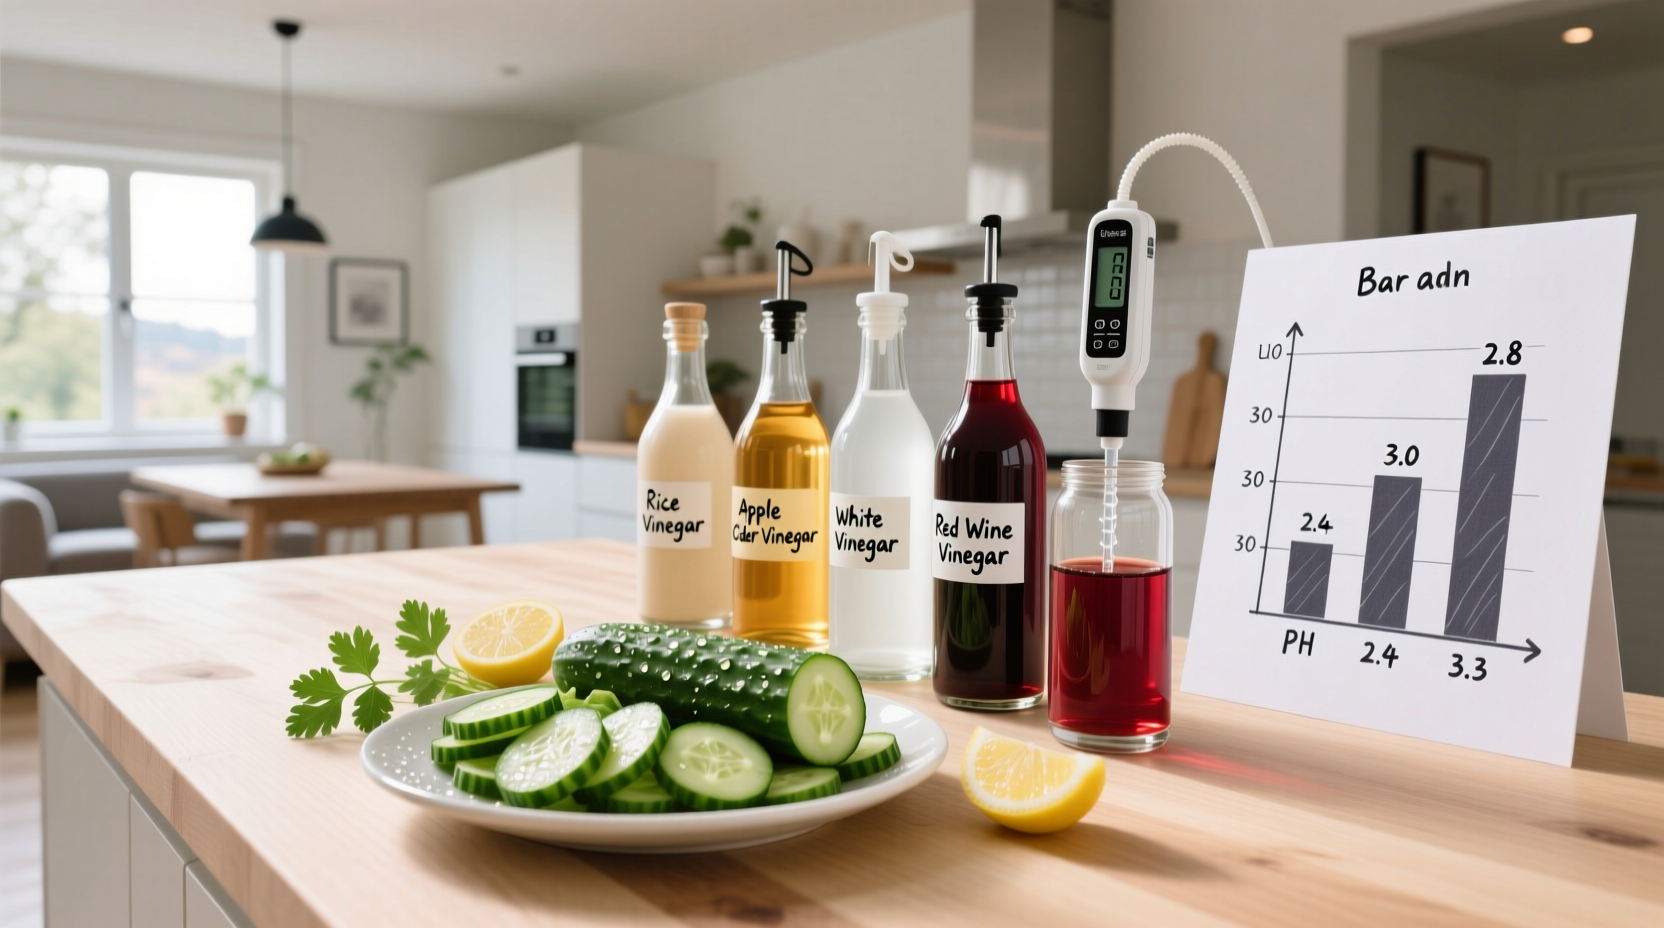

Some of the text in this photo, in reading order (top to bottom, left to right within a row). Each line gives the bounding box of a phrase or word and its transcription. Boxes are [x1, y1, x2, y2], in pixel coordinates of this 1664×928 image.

[1357, 260, 1470, 297] Bar adn
[1482, 340, 1524, 366] 2.8
[1250, 406, 1273, 424] 30
[1383, 443, 1420, 467] 3.0
[1241, 470, 1264, 488] 30
[646, 488, 680, 512] Rice
[738, 497, 782, 526] Apple
[642, 515, 705, 543] Vinegar
[834, 505, 884, 530] White
[935, 512, 1014, 540] Red Wine
[1300, 512, 1334, 534] 2.4
[761, 526, 819, 554] Vinegar
[834, 530, 899, 563] Vinegar
[1235, 535, 1257, 553] 30
[938, 542, 1010, 576] Vinegar
[1282, 629, 1315, 657] PH
[1359, 641, 1399, 669] 2.4
[1447, 653, 1488, 682] 3.3
